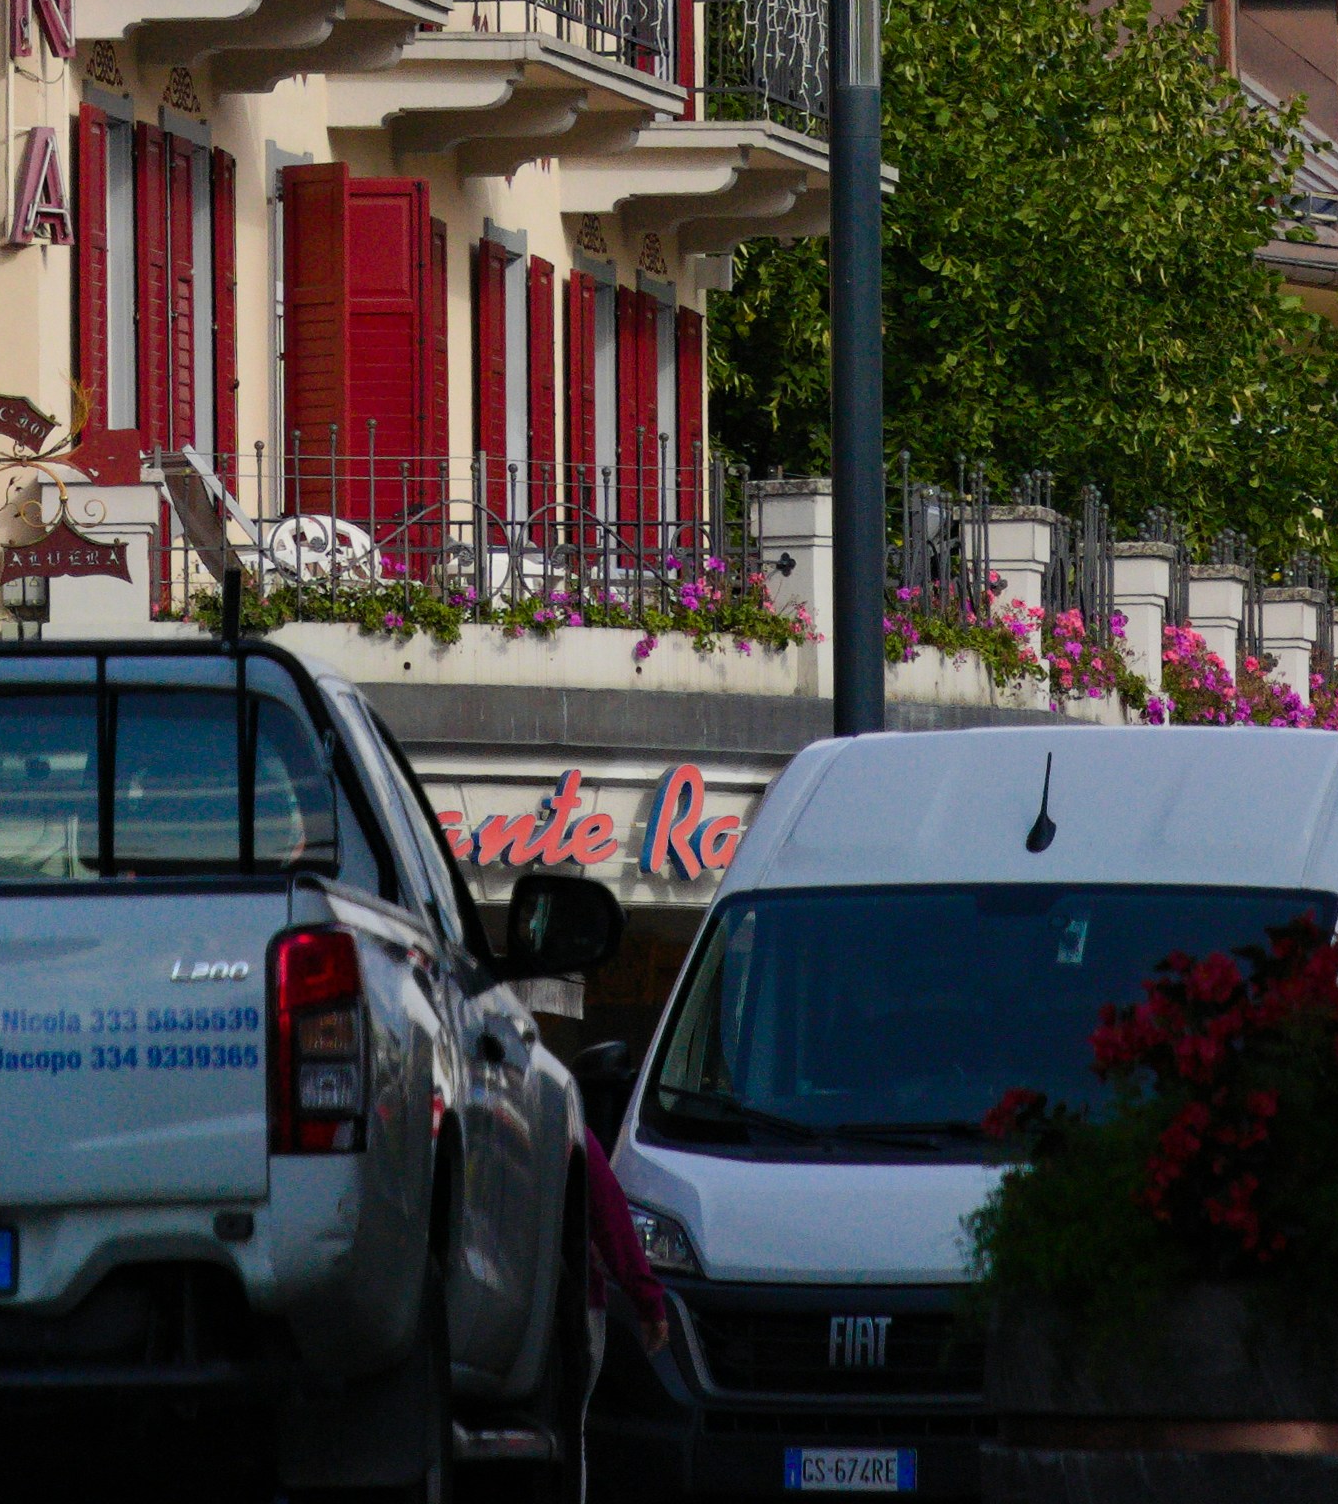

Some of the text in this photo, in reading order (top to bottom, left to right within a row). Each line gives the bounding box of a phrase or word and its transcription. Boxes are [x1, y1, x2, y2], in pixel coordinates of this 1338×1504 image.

[170, 960, 249, 982] L200
[1, 1008, 81, 1033] Nicola
[91, 1007, 137, 1033] 333
[91, 1045, 138, 1071] 334
[828, 1315, 892, 1368] FIAT
[835, 1458, 897, 1484] 674RE
